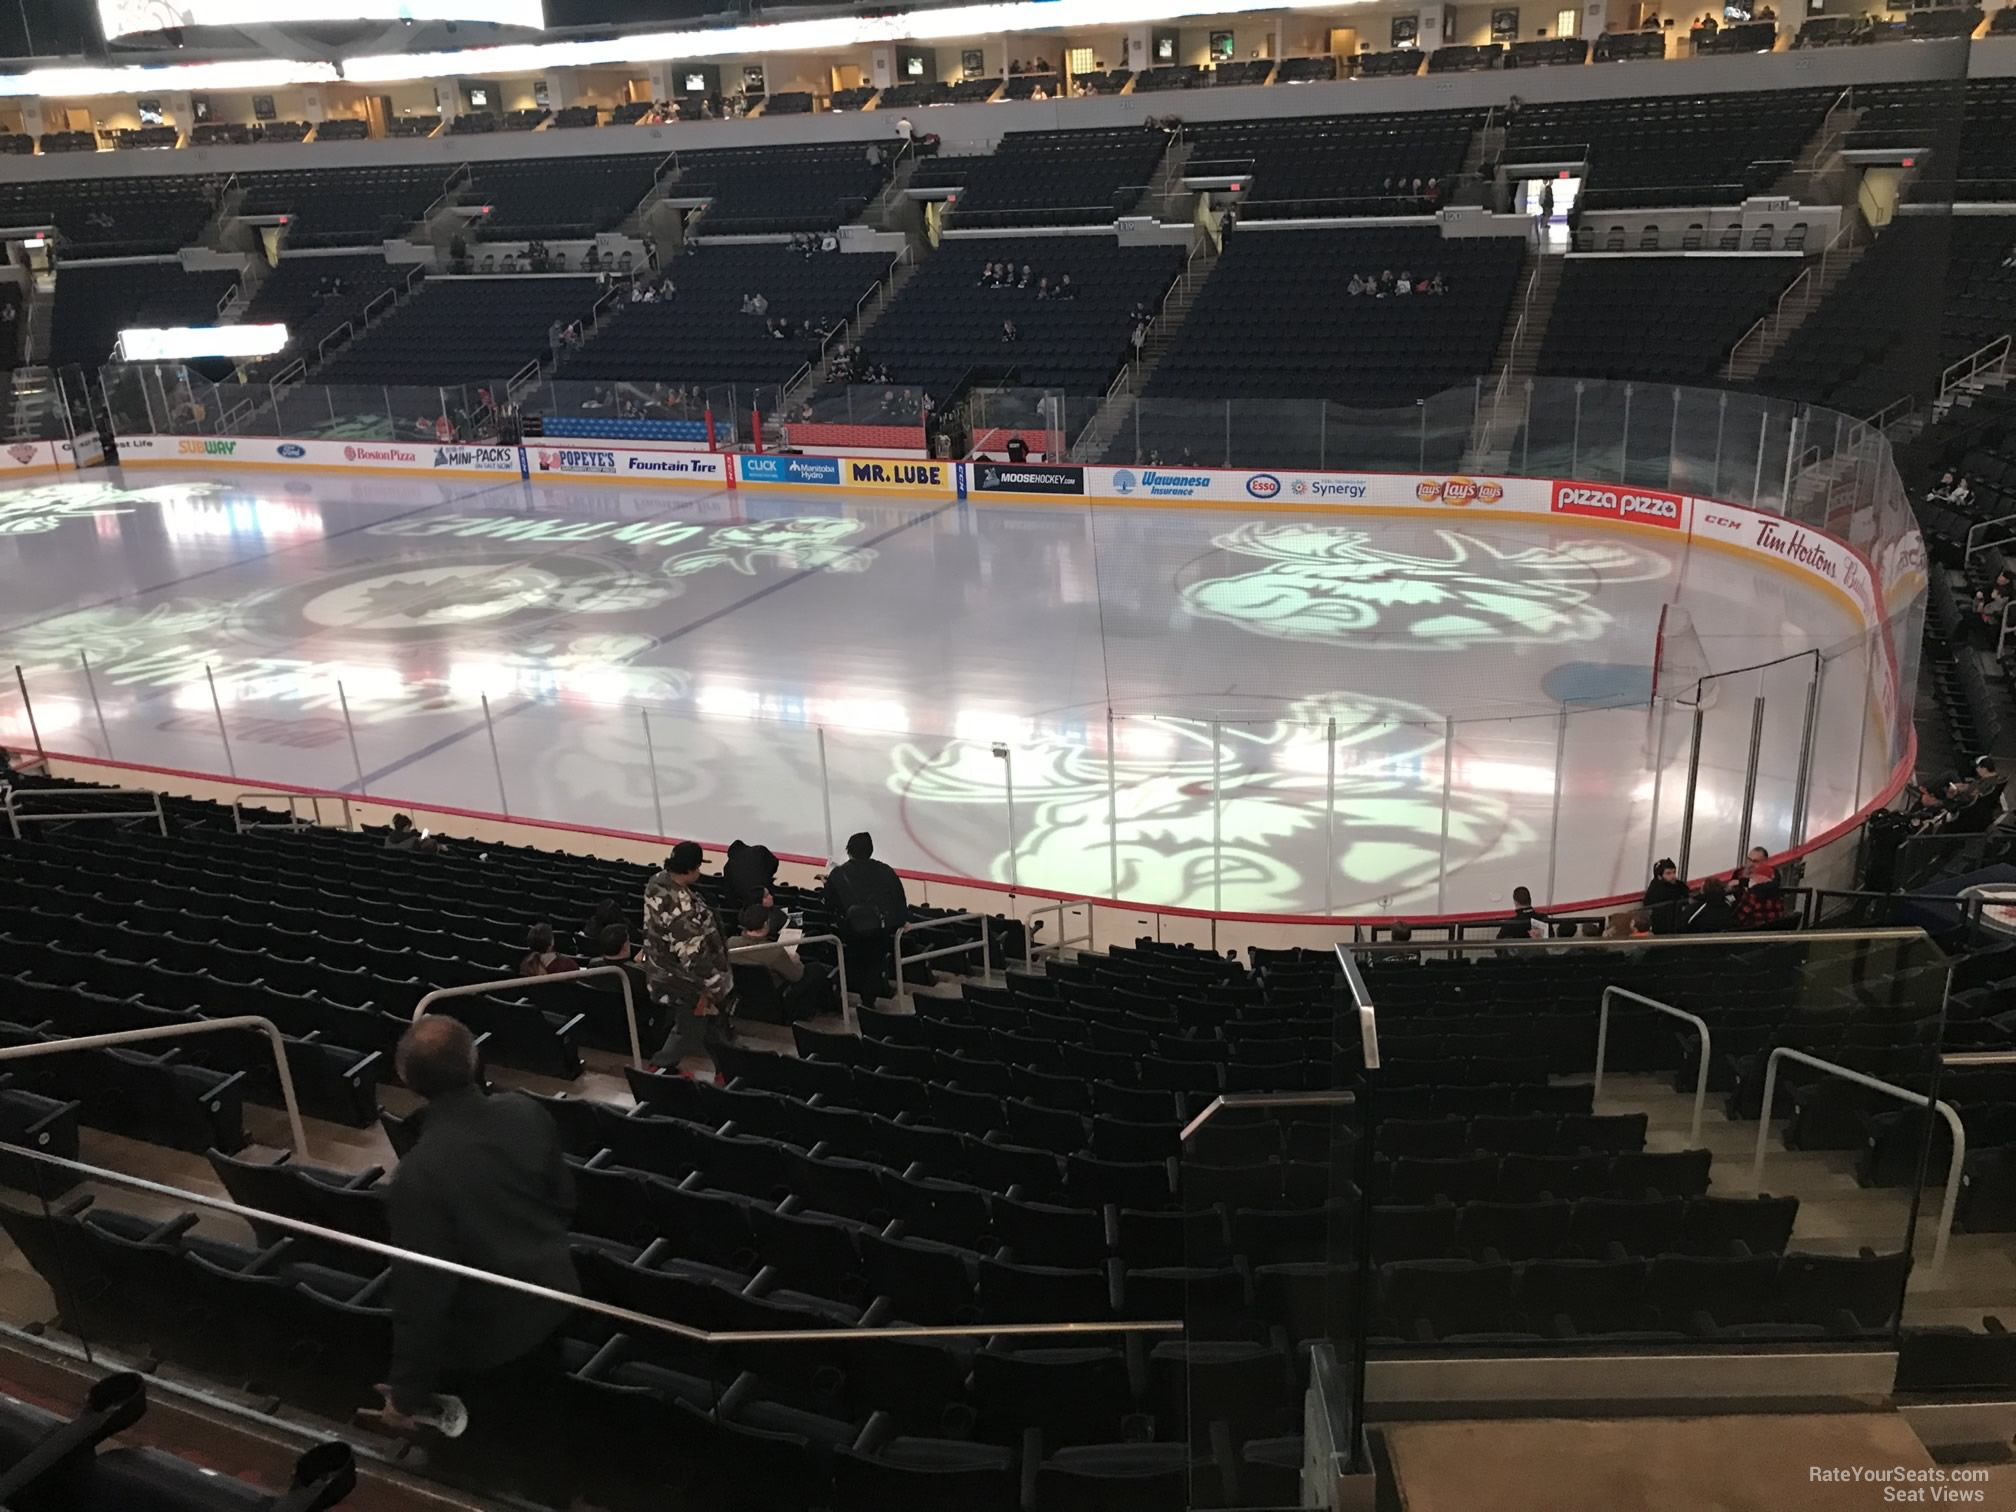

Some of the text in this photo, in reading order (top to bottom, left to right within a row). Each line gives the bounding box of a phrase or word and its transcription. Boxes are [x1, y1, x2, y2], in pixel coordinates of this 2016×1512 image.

[1443, 211, 1462, 222] 120
[1119, 221, 1136, 231] 119
[133, 440, 153, 448] Life
[178, 440, 237, 455] SUBWAY
[279, 444, 302, 457] Ford
[357, 448, 416, 462] Boston Pizza
[449, 448, 512, 466] MINI-PACKS
[559, 450, 615, 467] POPEYE'S
[629, 457, 688, 472] Fountain
[690, 460, 717, 473] Tire
[747, 460, 777, 471] CLICK
[800, 464, 835, 473] Manitoba
[801, 472, 824, 480] Hydro
[852, 463, 941, 485] MR. LUBE
[1141, 471, 1211, 488] Wawanesa
[1150, 486, 1195, 496] Insurance
[1252, 480, 1276, 492] Esso
[1311, 481, 1367, 498] Synergy
[1558, 487, 1677, 519] pizza pizza
[1703, 514, 1743, 530] CCM
[1757, 519, 1837, 578] Tim Hortons
